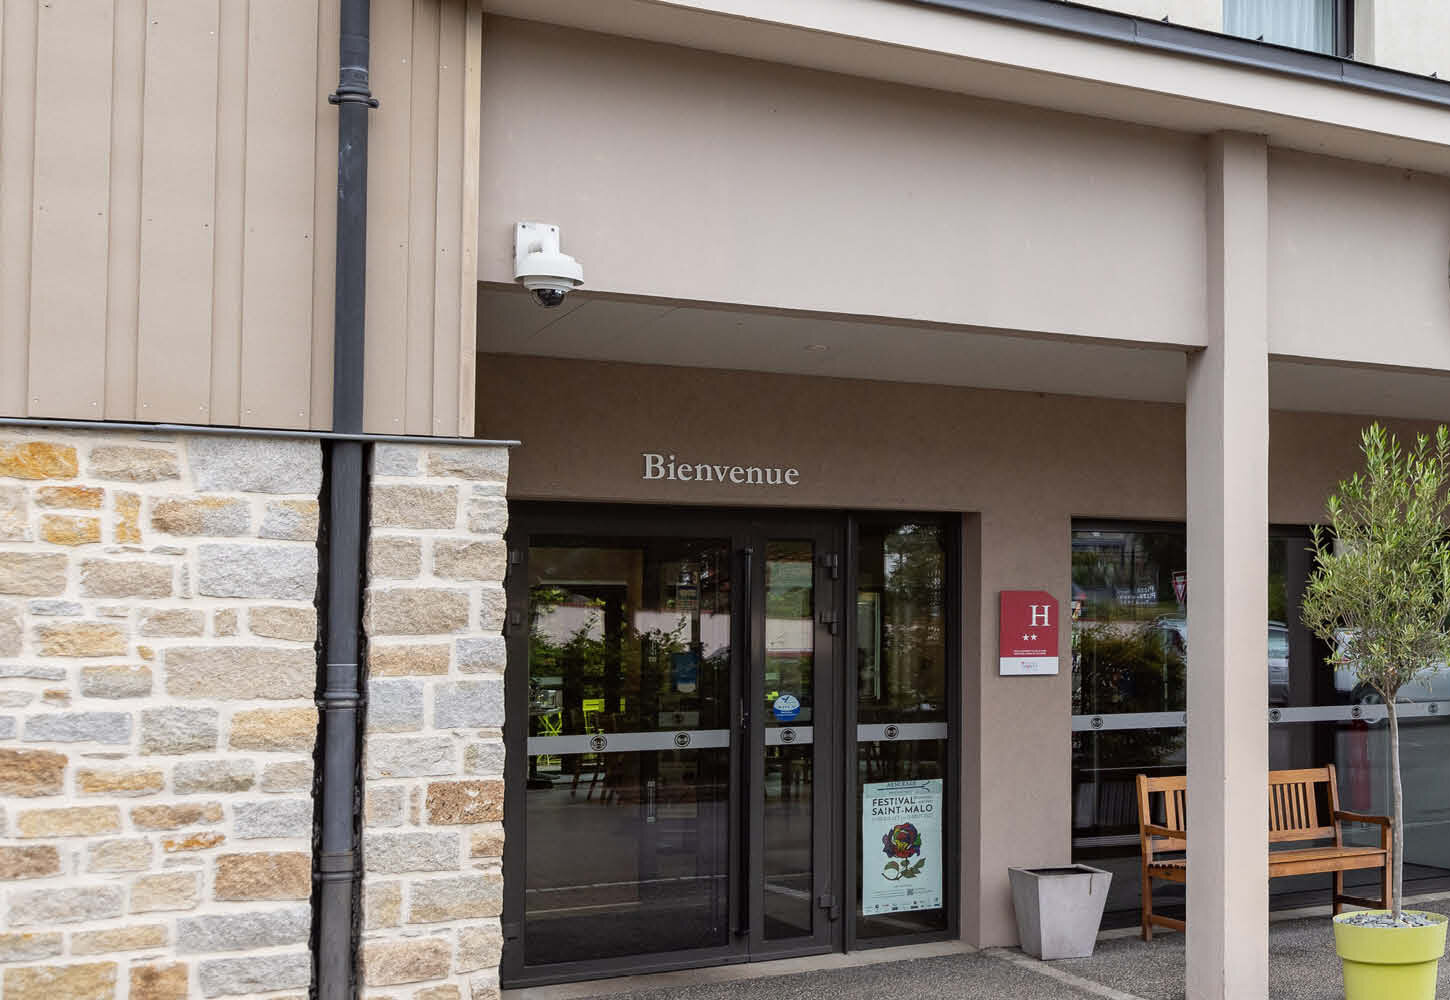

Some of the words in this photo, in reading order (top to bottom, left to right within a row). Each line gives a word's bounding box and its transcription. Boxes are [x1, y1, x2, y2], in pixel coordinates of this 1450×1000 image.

[642, 453, 800, 485] Bienvenue
[1028, 604, 1052, 627] H
[872, 796, 916, 807] FESTIVAL
[872, 804, 933, 816] SAINT-MALO
